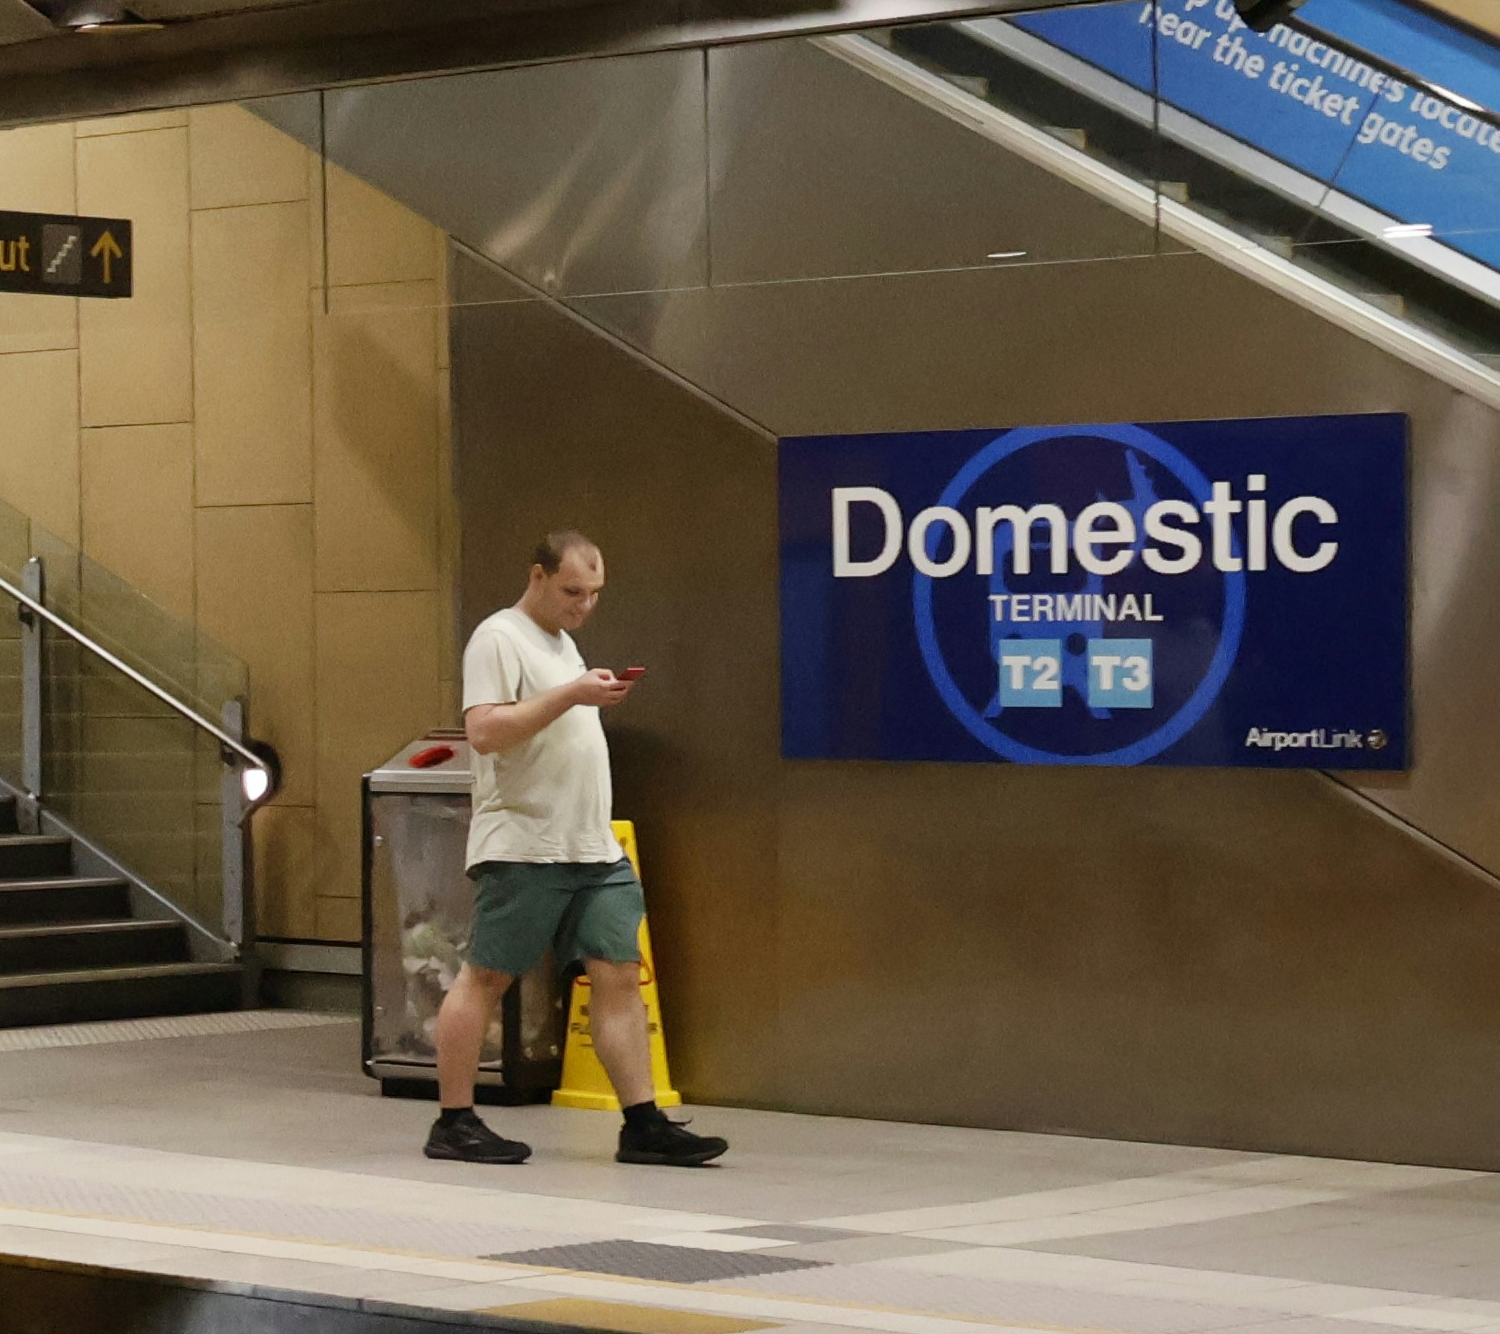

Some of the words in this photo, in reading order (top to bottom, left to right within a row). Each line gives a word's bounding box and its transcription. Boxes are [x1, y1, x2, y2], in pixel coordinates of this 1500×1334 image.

[1212, 33, 1265, 79] the
[1268, 60, 1360, 126] ticket
[1357, 112, 1452, 170] gates
[830, 474, 1340, 579] Domestic
[988, 593, 1164, 624] TERMINAL
[1001, 654, 1062, 692] T2
[1090, 654, 1152, 692] T3
[1244, 726, 1364, 752] AirportLink
